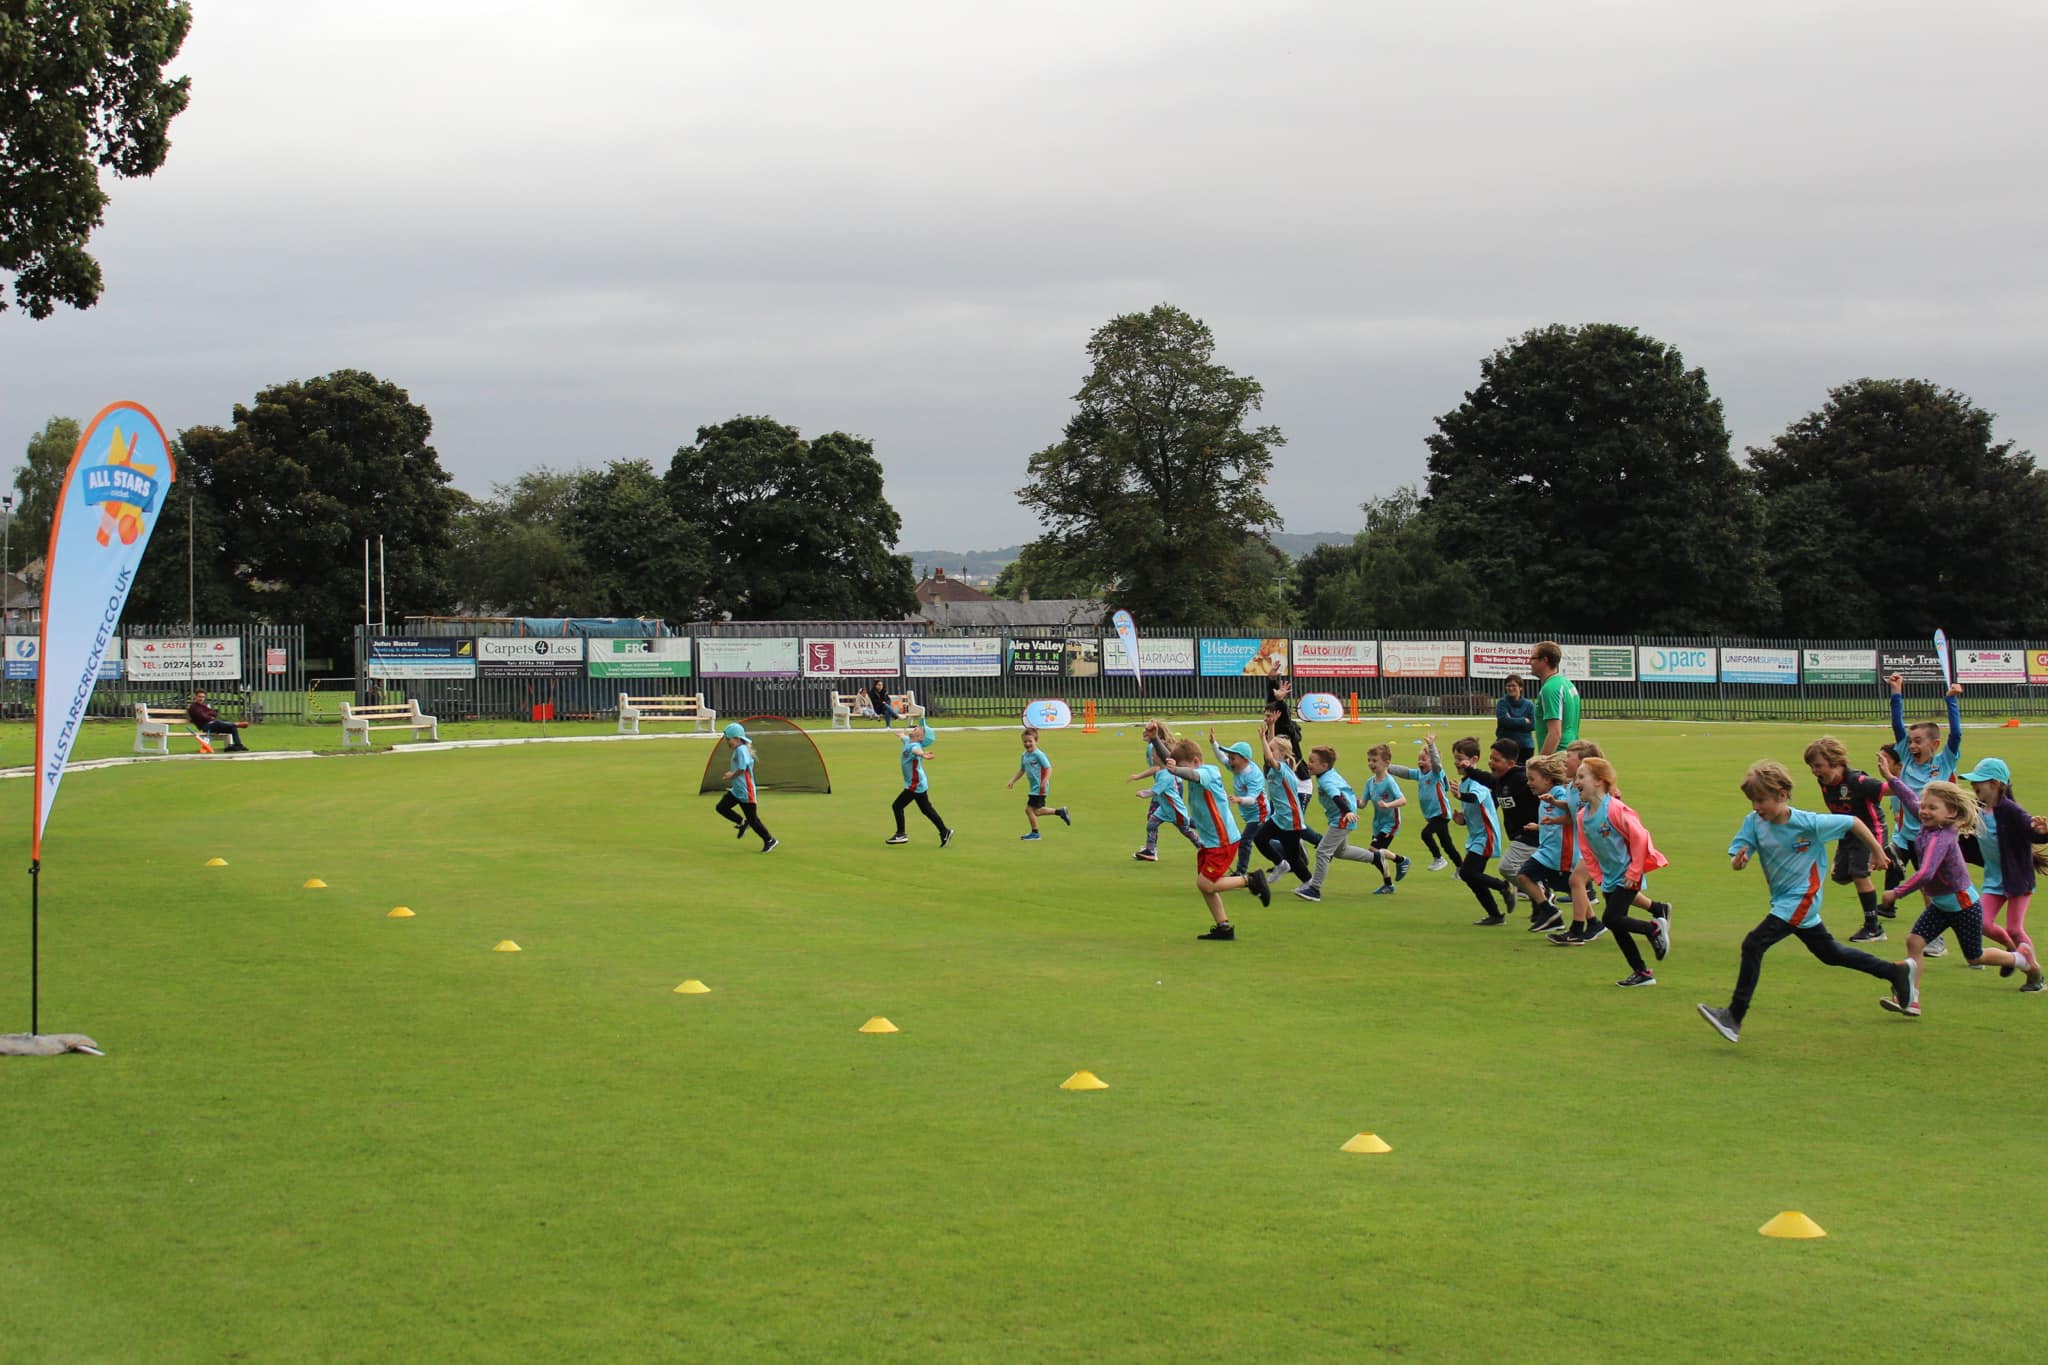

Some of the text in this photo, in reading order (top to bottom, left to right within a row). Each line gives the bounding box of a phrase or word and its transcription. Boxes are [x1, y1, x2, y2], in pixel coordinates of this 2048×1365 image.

[89, 470, 151, 497] ALL STARS
[485, 641, 577, 656] Carpets 4 Less
[843, 641, 894, 649] MARTINEZ
[1009, 640, 1030, 650] Aire
[1032, 640, 1065, 652] Valley
[1202, 640, 1256, 655] Websters
[1474, 646, 1496, 654] Stuart
[1498, 647, 1516, 655] Price
[1014, 652, 1059, 660] RESIN
[1139, 653, 1191, 664] HARMACY
[1669, 650, 1707, 672] parc
[1883, 655, 1917, 666] Farsley
[163, 661, 189, 669] 01274
[207, 660, 224, 668] 332
[48, 565, 132, 786] ALLSTARSCRICKET.CO.UK
